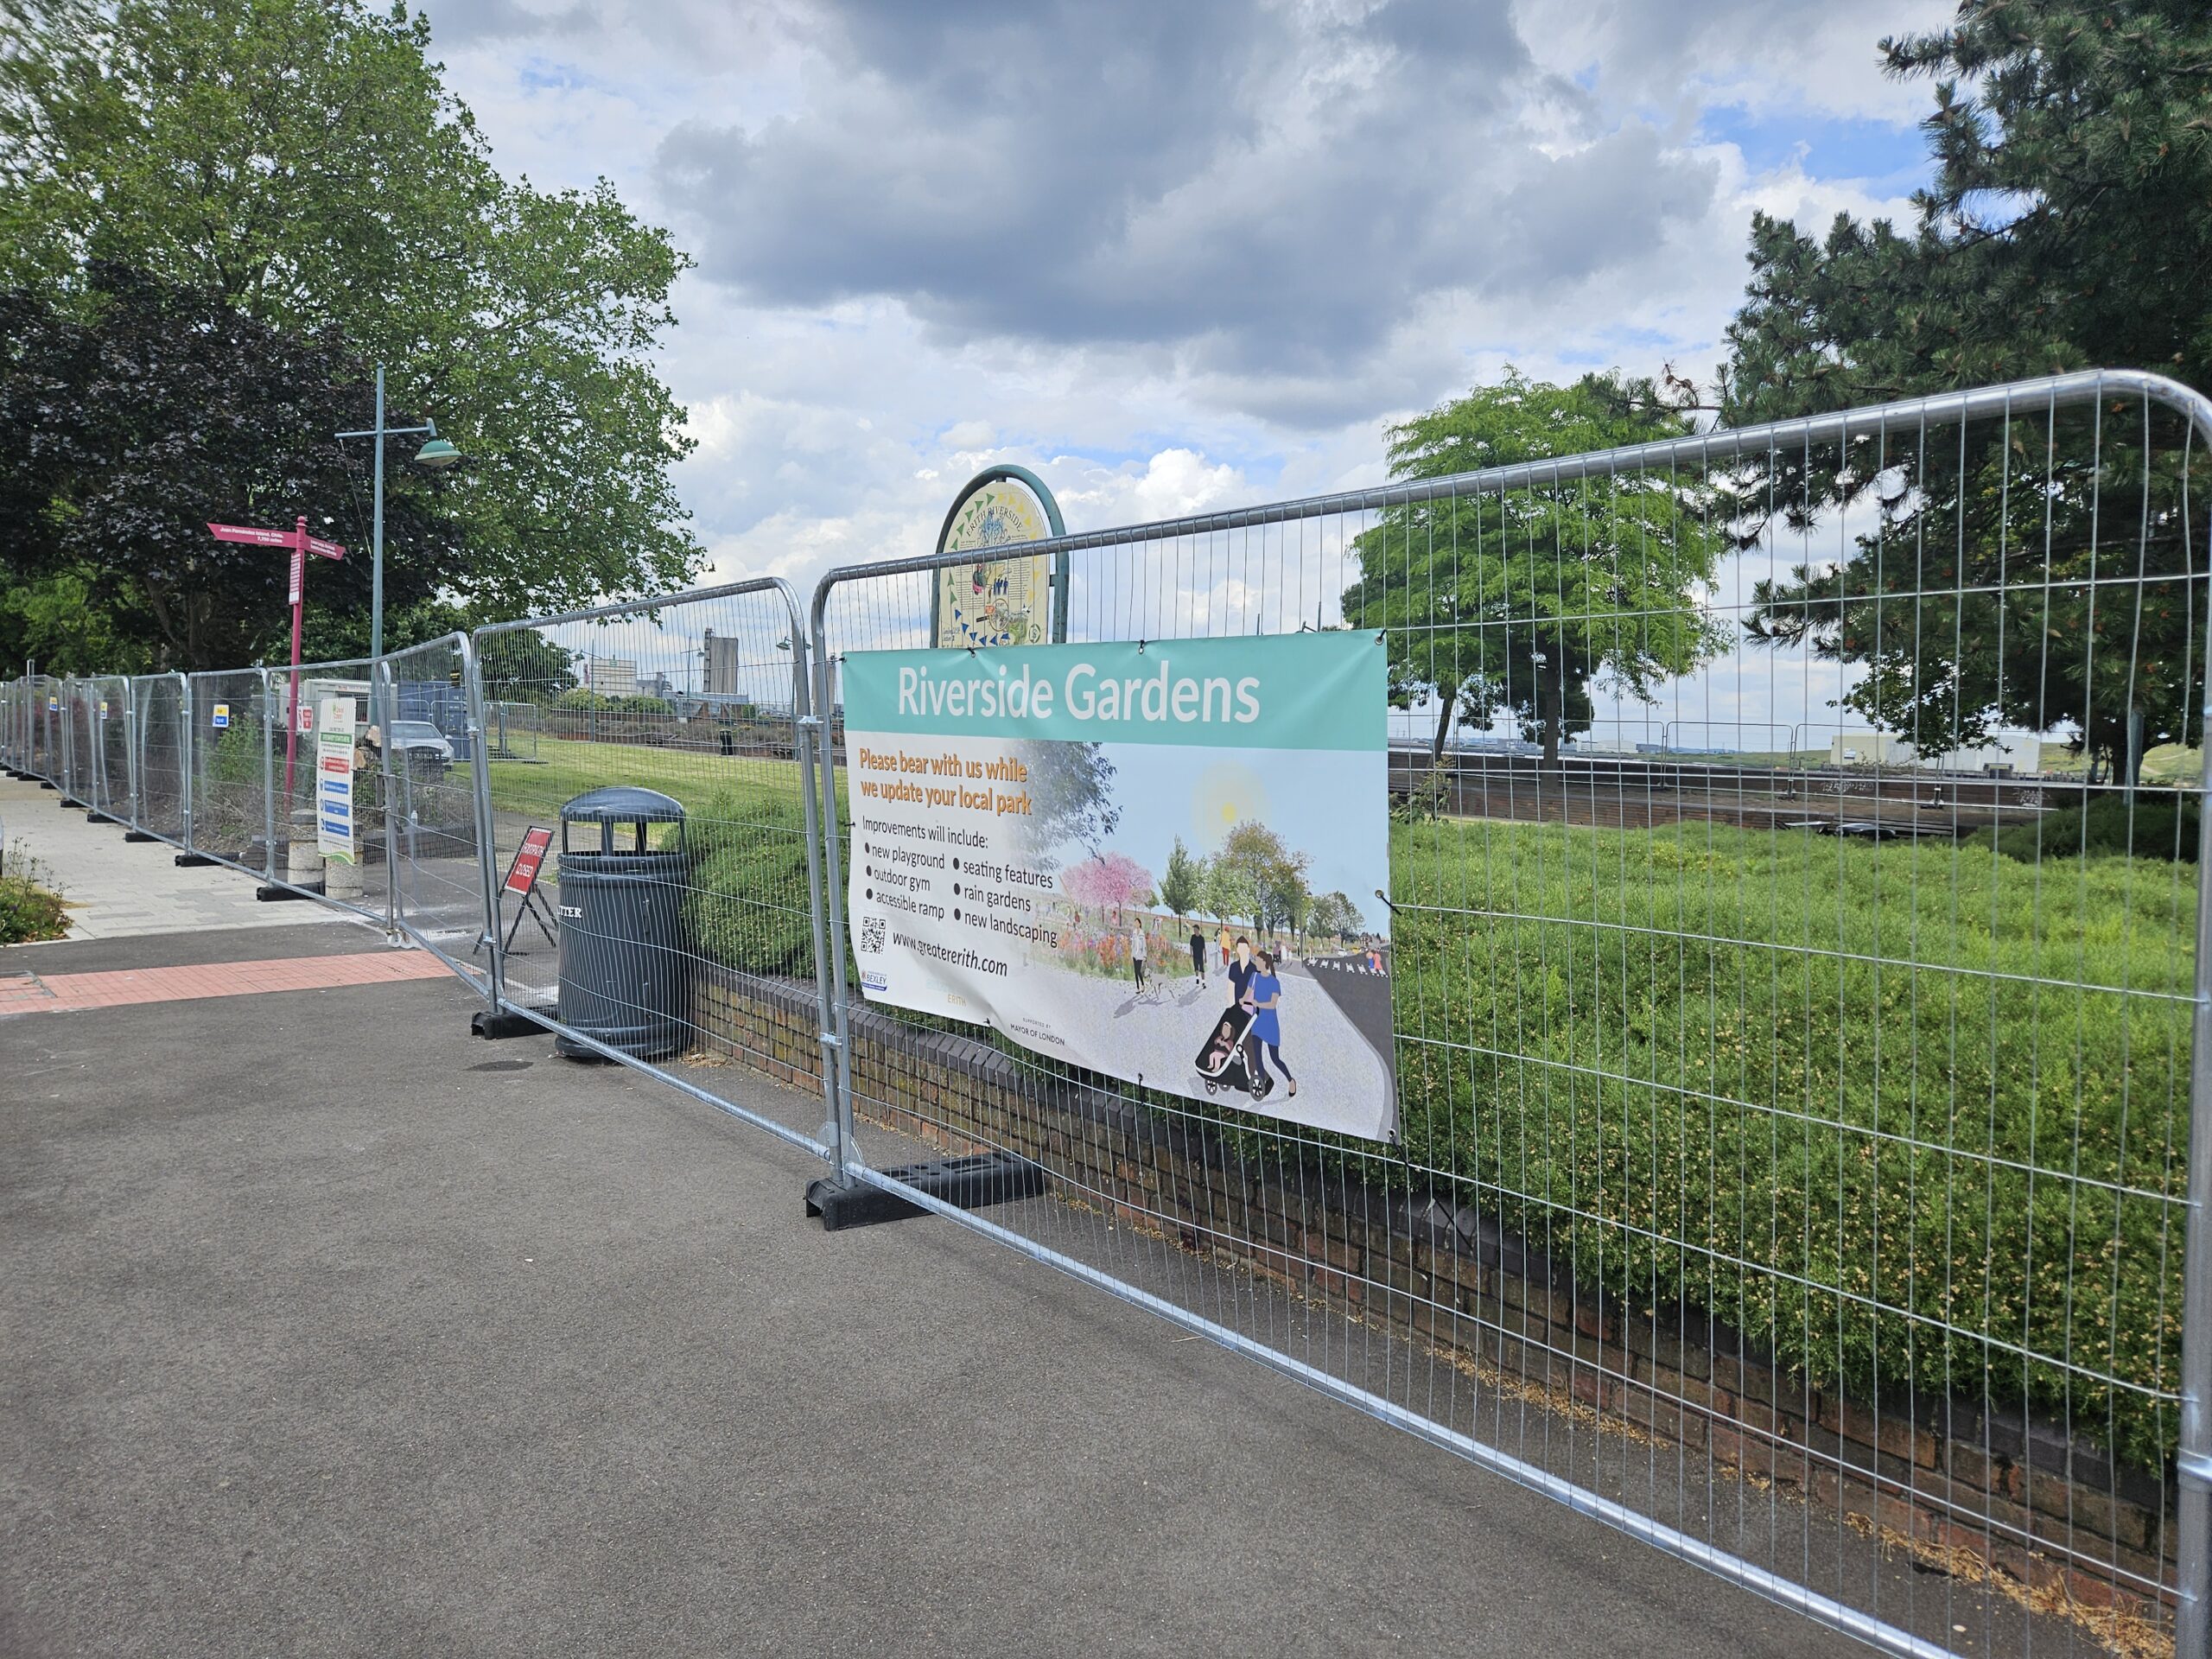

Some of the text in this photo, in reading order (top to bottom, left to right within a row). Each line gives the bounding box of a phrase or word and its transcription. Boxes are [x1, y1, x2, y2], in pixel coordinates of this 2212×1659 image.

[966, 505, 1023, 537] ERITH RIVERSIDE
[899, 660, 1261, 723] Riverside Gardens
[859, 747, 1027, 783] Please bear with us while
[860, 779, 1033, 817] we update your local park
[862, 815, 988, 849] Improvements will include:
[872, 845, 945, 869] new playground
[874, 868, 931, 893] outdoor gym
[963, 860, 1053, 889] seating features
[876, 891, 944, 922] accessible ramp
[963, 884, 1031, 912] rain gardens
[964, 910, 1058, 949] new landscaping
[893, 931, 1007, 977] www.greatererith.com
[867, 974, 887, 985] BEXLEY
[947, 994, 967, 1007] ERITH
[1010, 1023, 1029, 1036] MAYOR
[1039, 1032, 1065, 1046] LONDON
[1022, 1017, 1045, 1027] SUPPORTED
